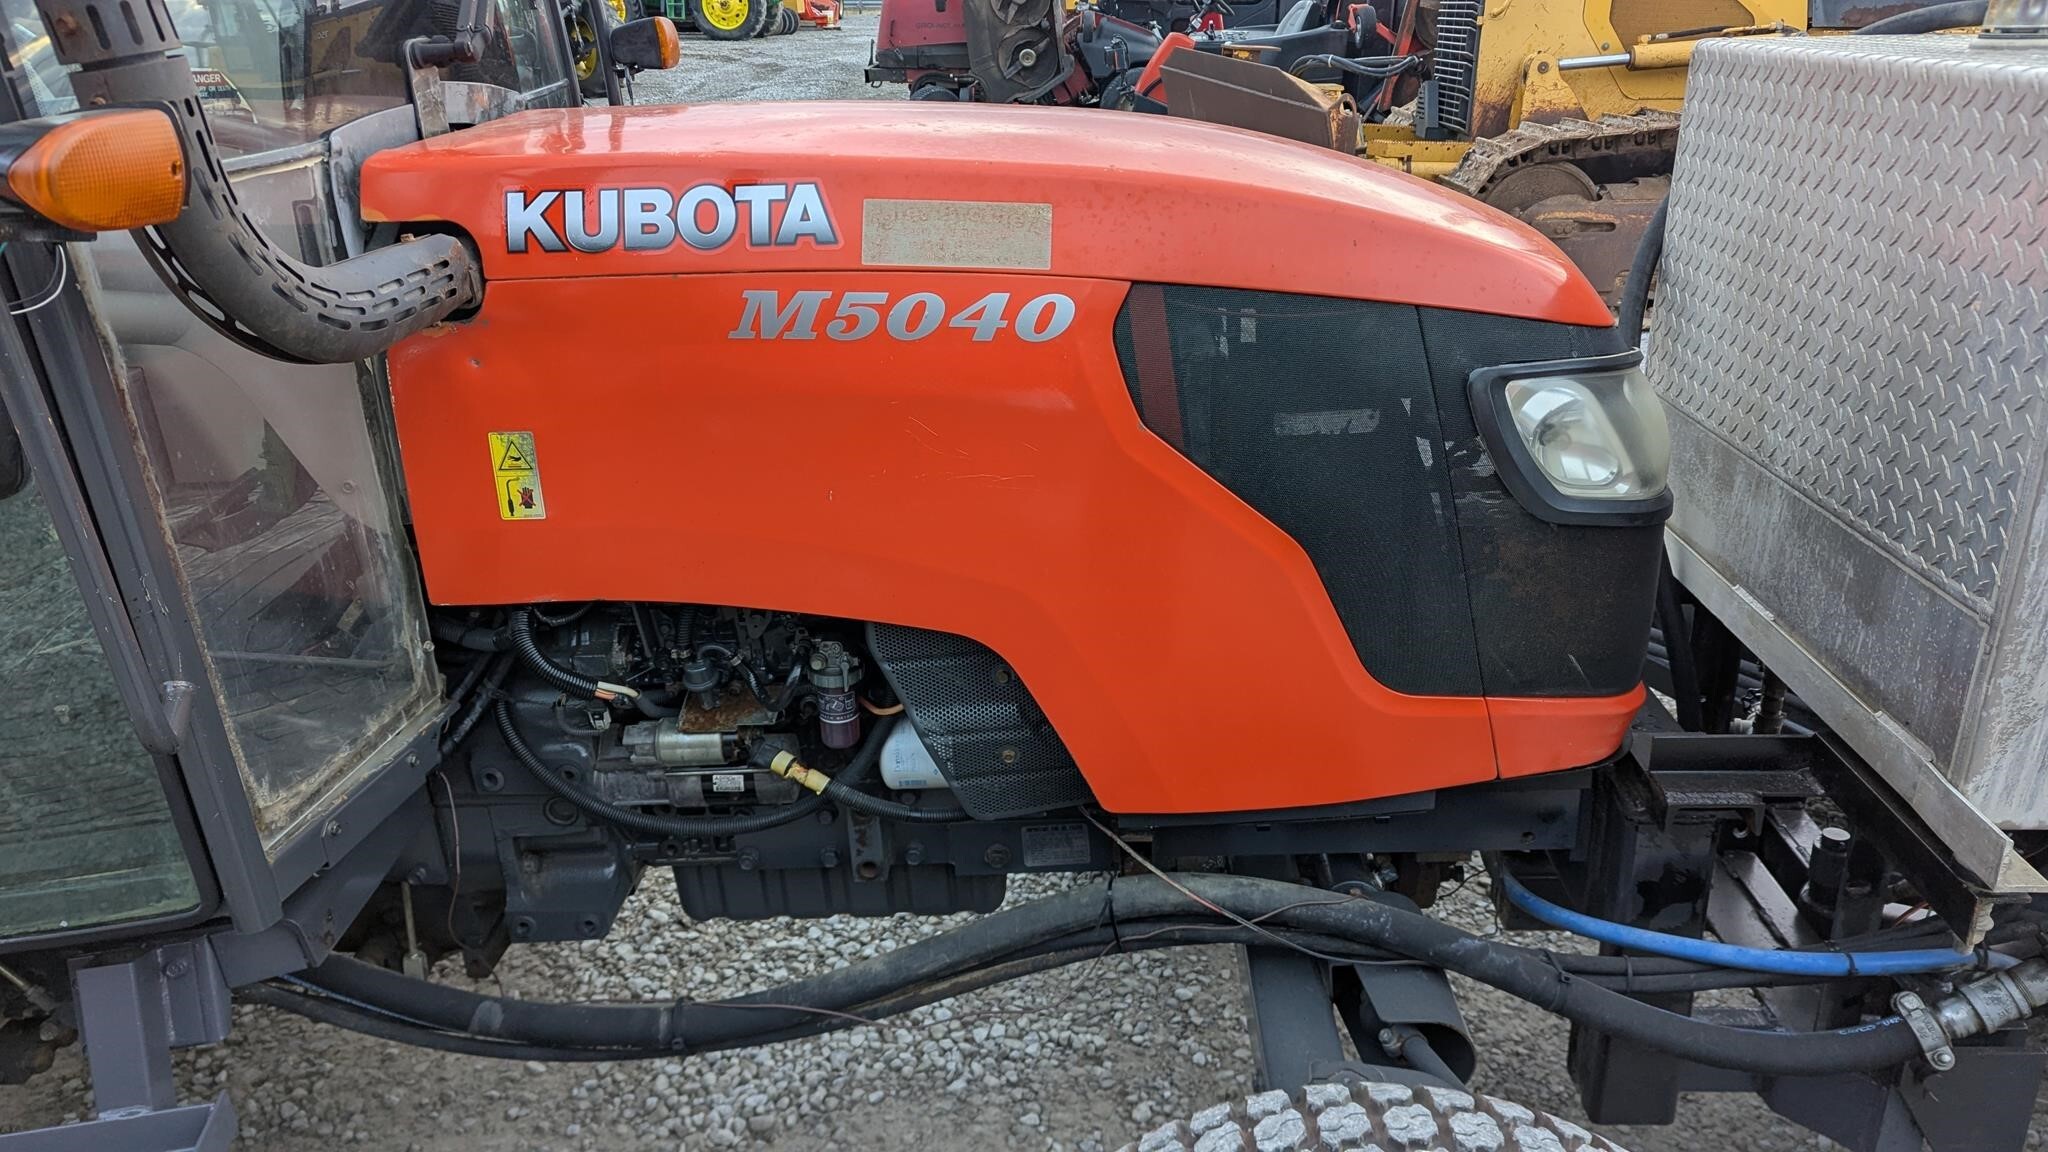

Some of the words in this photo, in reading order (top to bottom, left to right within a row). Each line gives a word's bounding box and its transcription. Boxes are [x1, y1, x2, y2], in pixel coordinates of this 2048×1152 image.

[193, 73, 222, 83] ANGER
[505, 183, 839, 254] KUBOTA
[728, 290, 1077, 343] M5040
